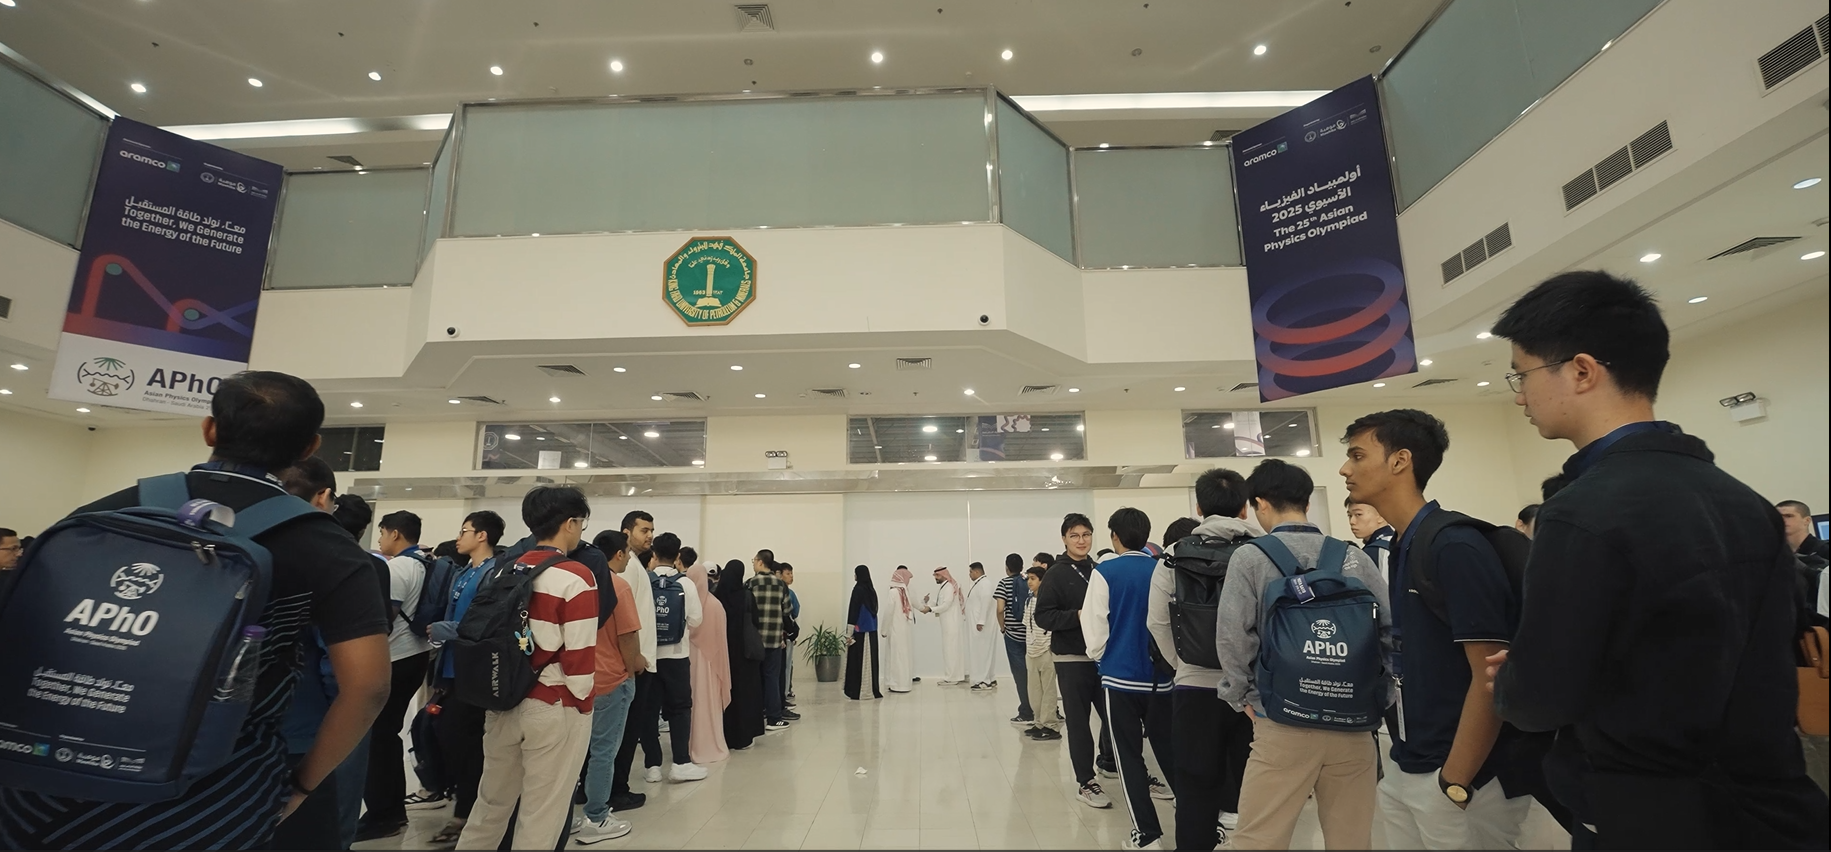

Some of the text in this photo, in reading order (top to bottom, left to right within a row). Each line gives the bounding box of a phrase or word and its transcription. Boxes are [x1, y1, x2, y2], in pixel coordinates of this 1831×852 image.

[119, 150, 166, 169] aramco
[1243, 149, 1277, 167] aramco
[177, 209, 201, 222] طاقة
[202, 216, 221, 228] نولد
[1271, 204, 1303, 223] 2025
[1273, 224, 1296, 237] The
[1319, 204, 1354, 223] Asian
[124, 206, 244, 244] Together, We Generate
[1264, 211, 1368, 252] Physics Olympiad
[121, 217, 243, 254] the Energy of the Future
[701, 309, 709, 320] OF
[146, 368, 222, 396] APhO
[144, 390, 213, 405] Asian Physics Olymp
[63, 598, 160, 636] APhO
[656, 606, 670, 614] PhO
[1303, 640, 1348, 657] APhO
[491, 652, 499, 698] AIRWALK
[1283, 707, 1310, 719] aramco
